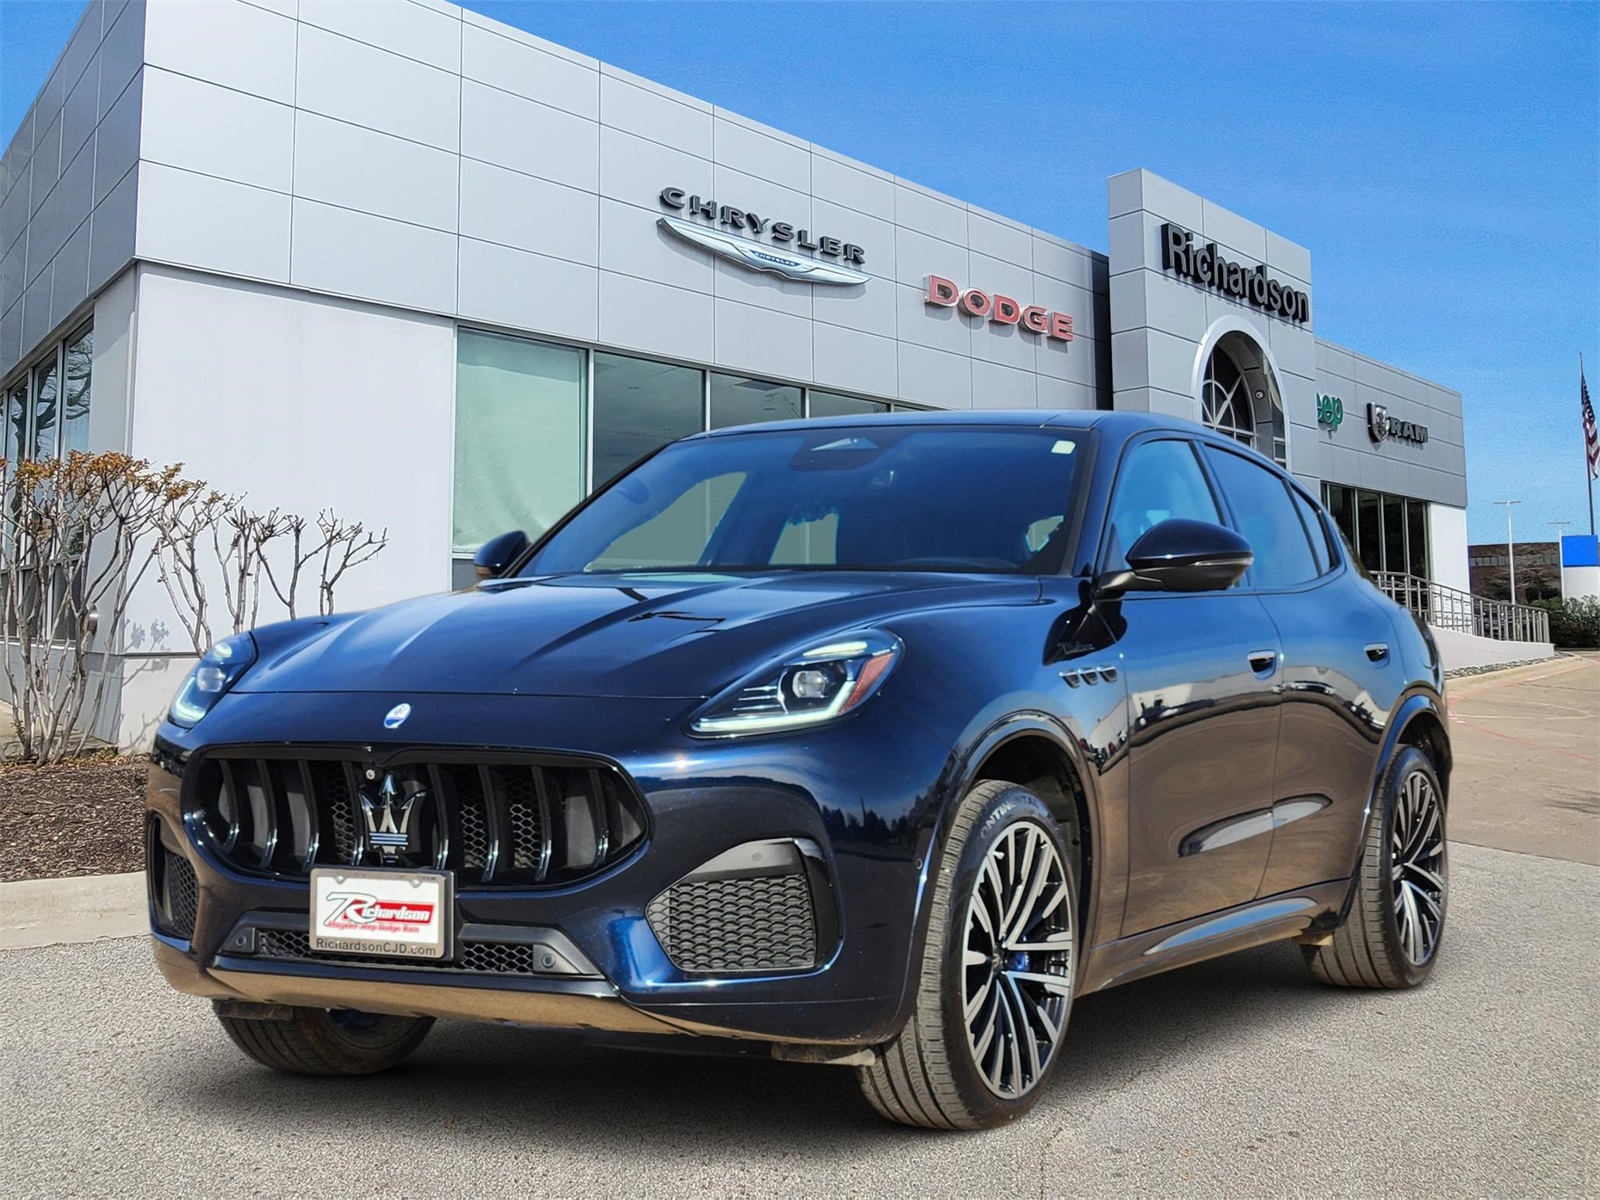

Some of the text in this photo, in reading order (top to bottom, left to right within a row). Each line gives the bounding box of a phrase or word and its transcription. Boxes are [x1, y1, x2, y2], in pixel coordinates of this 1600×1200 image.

[659, 186, 866, 264] CHRYSLER
[1161, 222, 1310, 323] Richardson
[923, 274, 1074, 342] DODGE
[1316, 391, 1344, 433] eep
[1387, 416, 1429, 443] RAM
[323, 891, 431, 927] Richardson
[316, 938, 436, 956] RichardsonCJD.com
